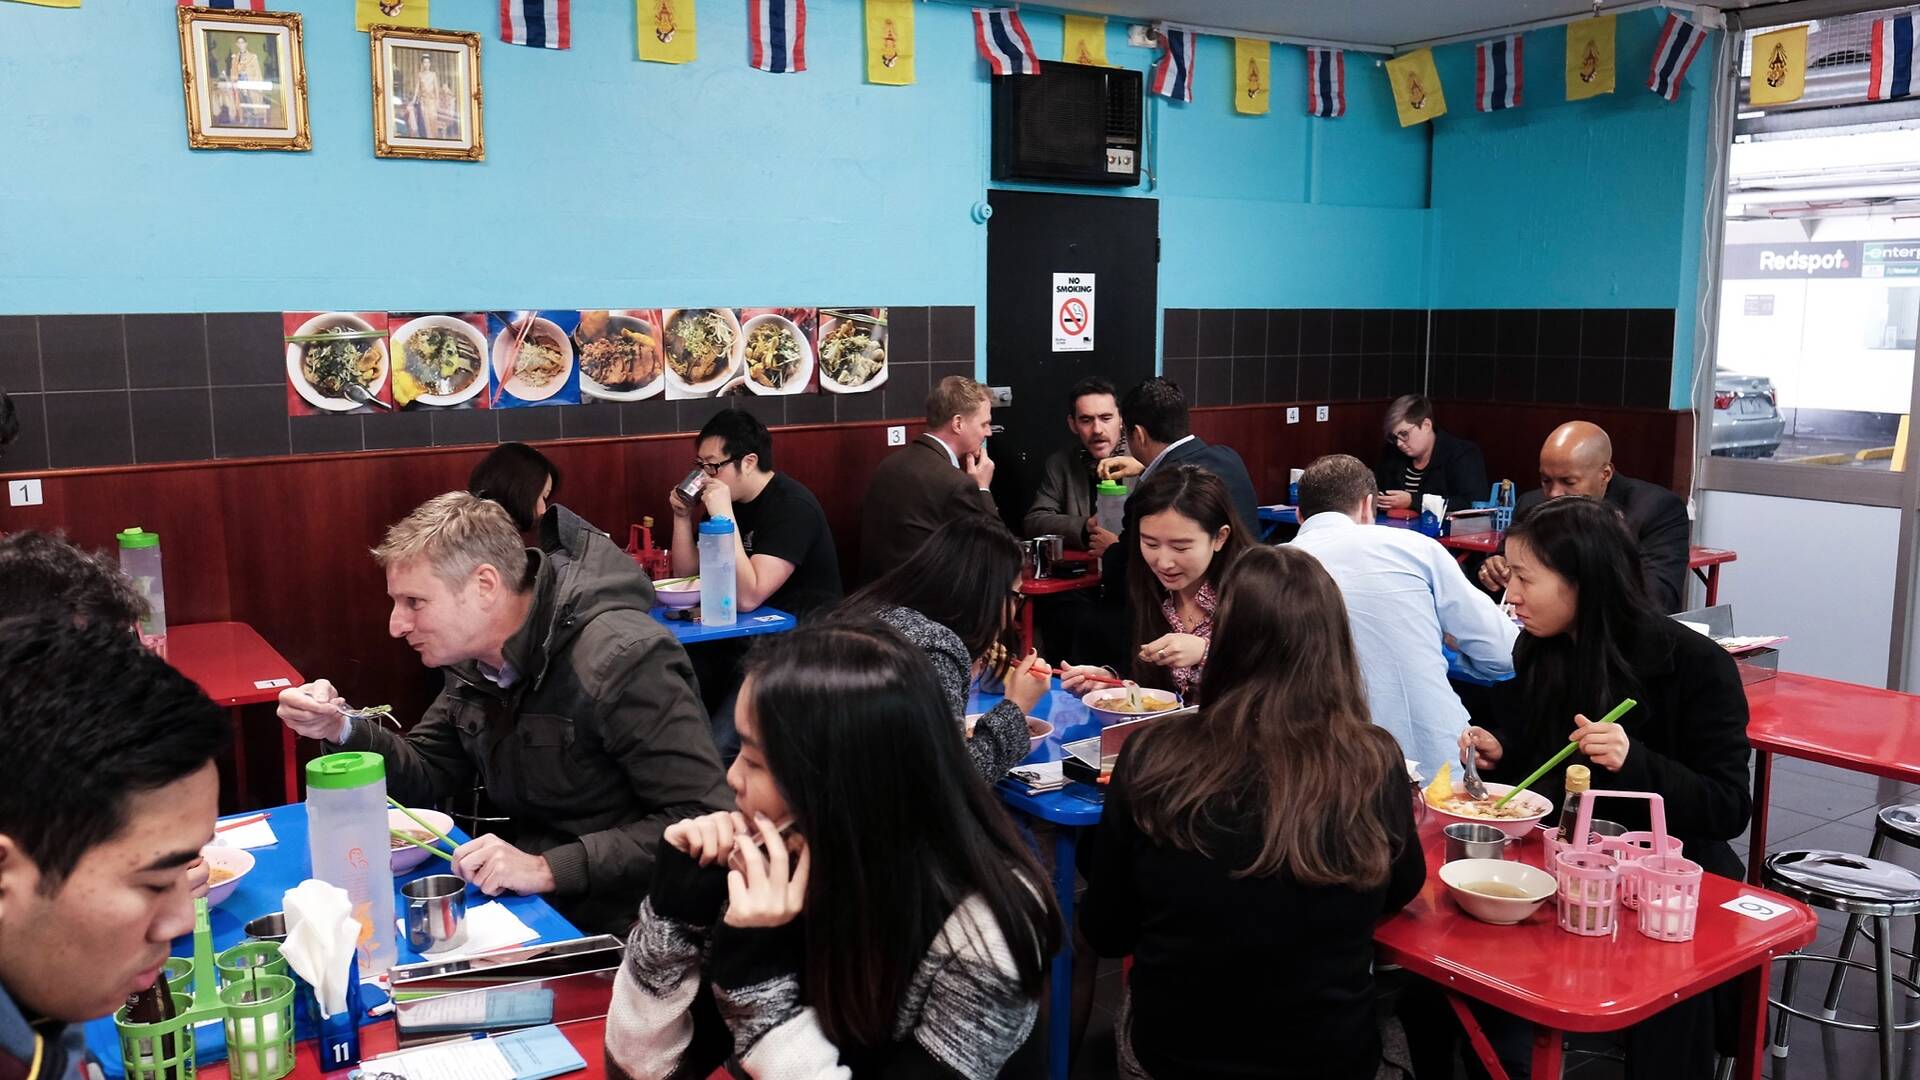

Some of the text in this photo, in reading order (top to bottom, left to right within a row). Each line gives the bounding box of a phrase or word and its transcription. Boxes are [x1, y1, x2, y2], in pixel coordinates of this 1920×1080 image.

[1068, 277, 1081, 285] NO
[1056, 285, 1093, 293] SMOKING
[1319, 408, 1326, 420] 5
[892, 429, 901, 444] 3
[19, 484, 29, 502] 1
[332, 1041, 350, 1063] 11
